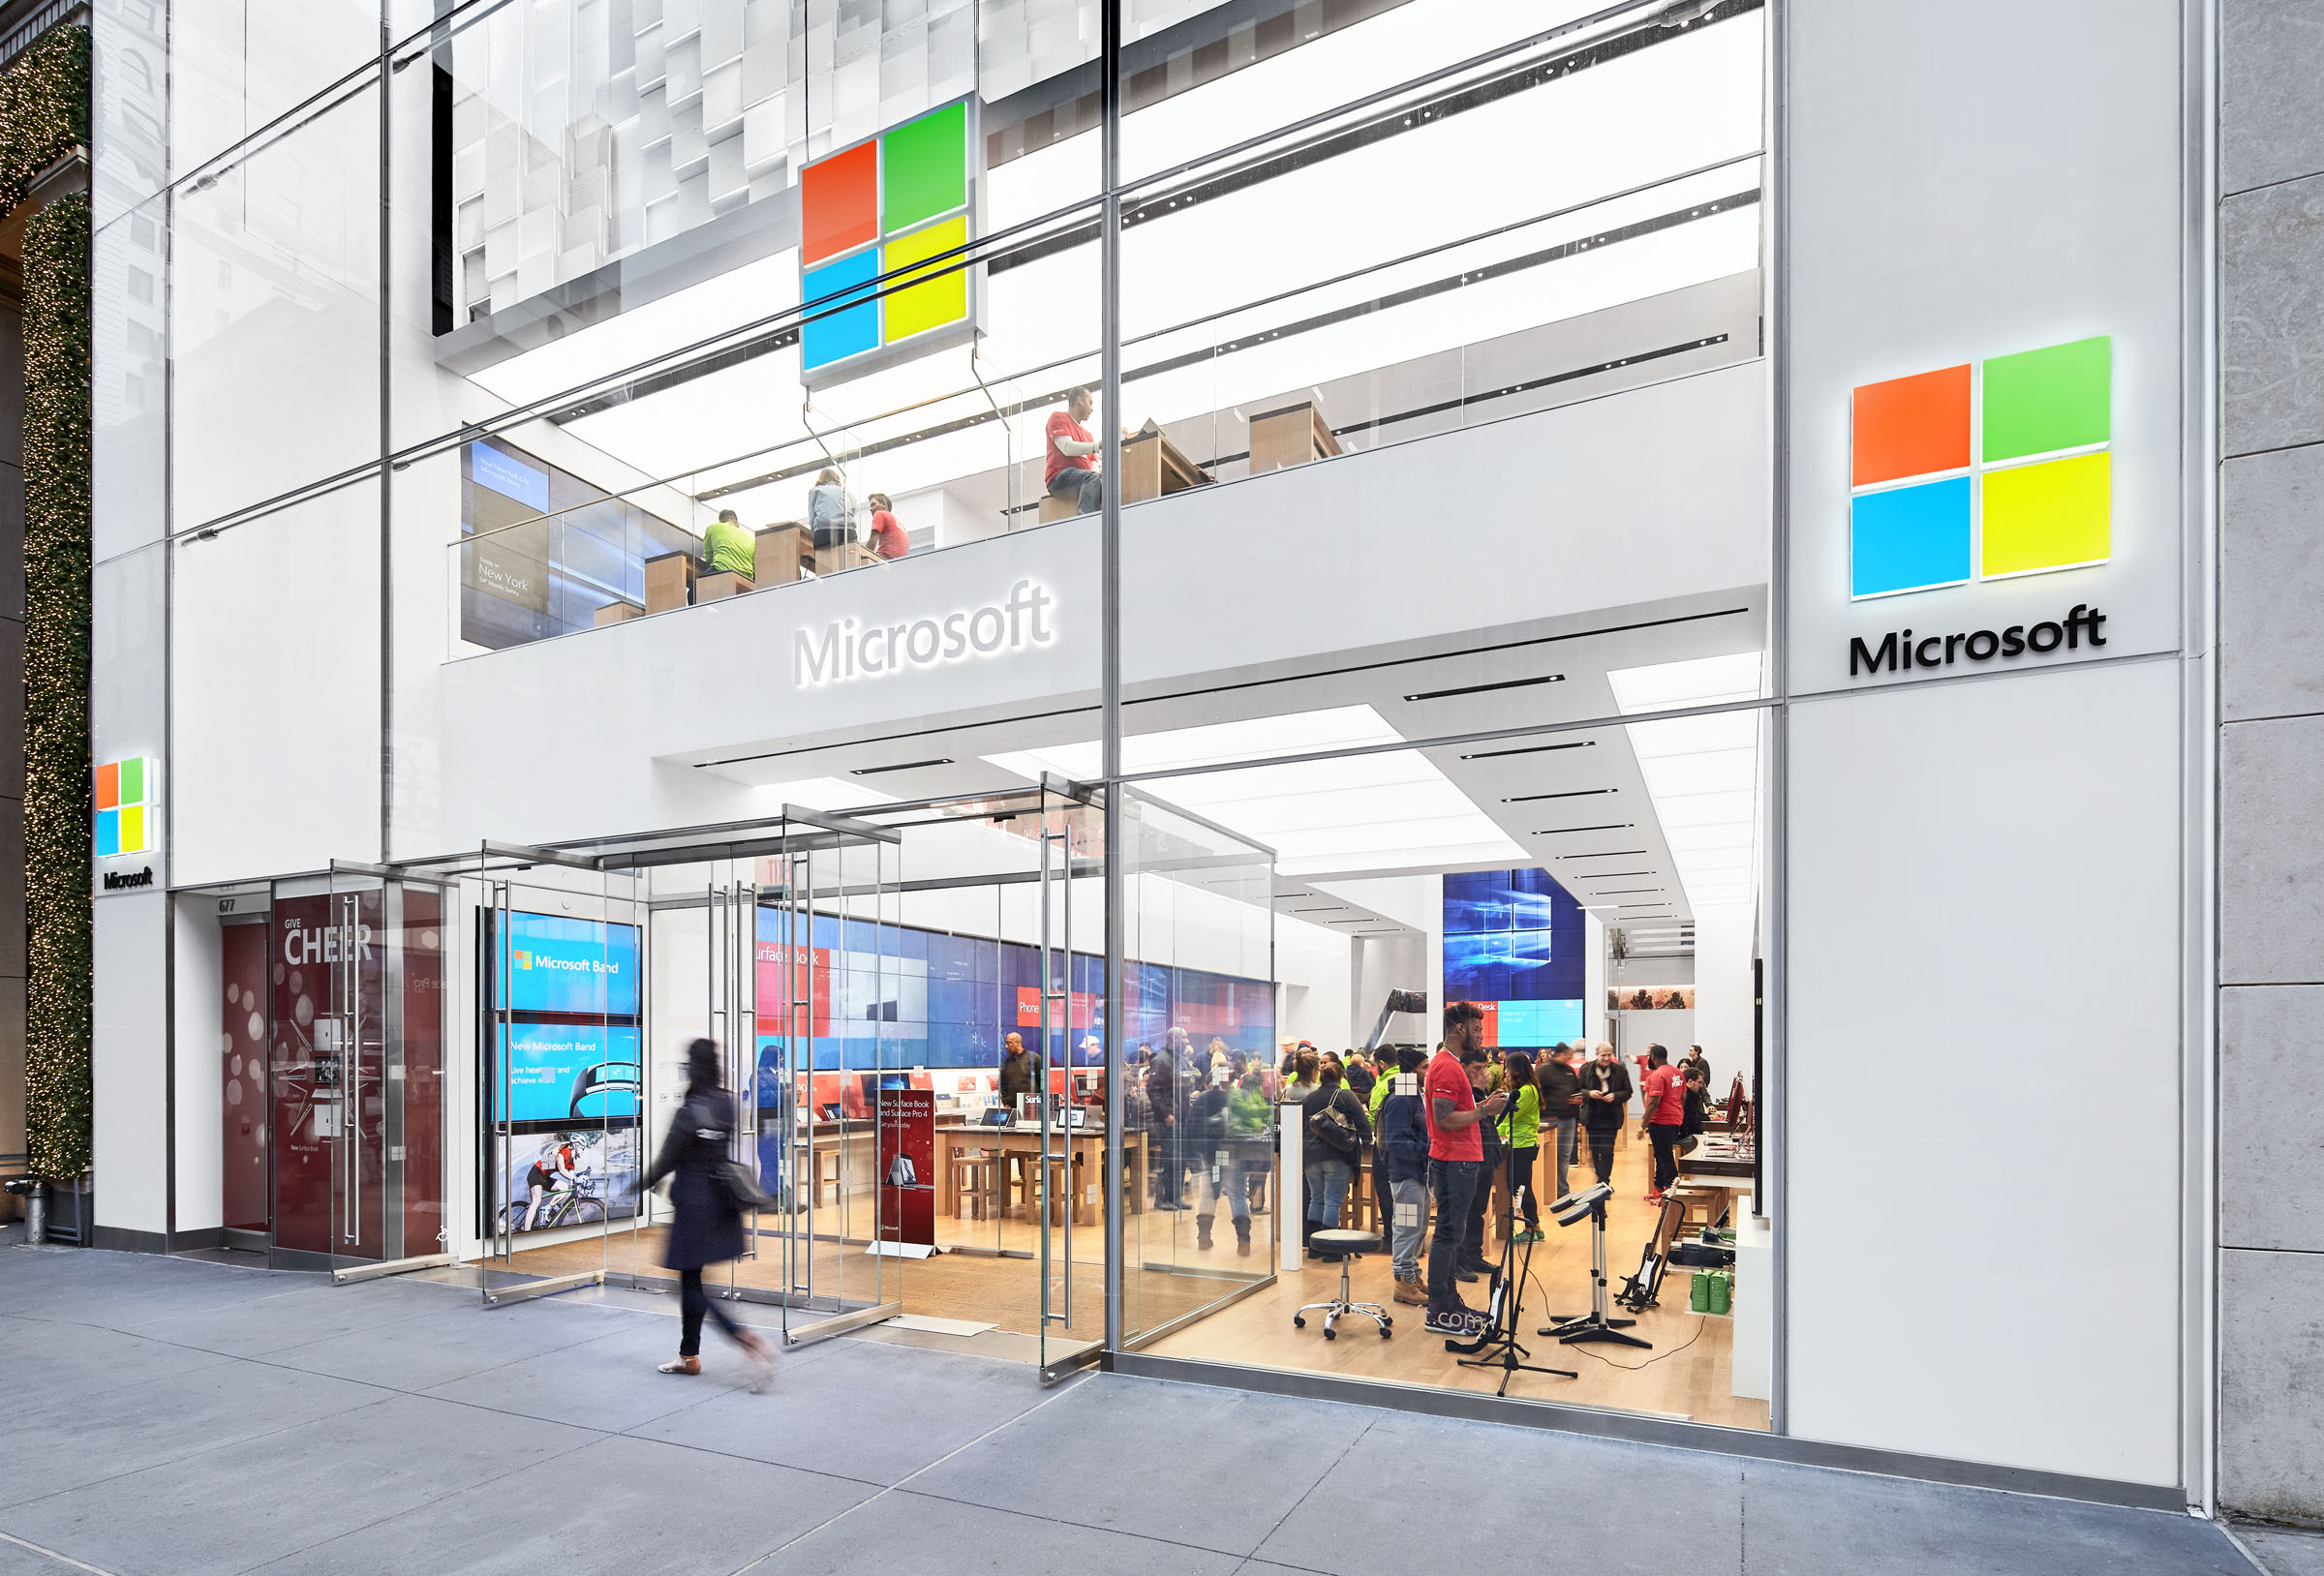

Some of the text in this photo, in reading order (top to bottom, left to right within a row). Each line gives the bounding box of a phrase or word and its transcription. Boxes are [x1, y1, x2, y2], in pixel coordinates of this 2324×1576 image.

[478, 563, 528, 591] New York
[794, 579, 1051, 685] Microsoft
[1850, 603, 2107, 676] Microsoft
[104, 865, 153, 890] Microsoft
[218, 898, 235, 913] 677
[285, 918, 301, 929] GIVE
[285, 924, 373, 965] CHEER
[535, 955, 619, 974] Microsoft Band
[1020, 1001, 1039, 1014] Phone
[511, 1042, 596, 1051] New Microsoft Band
[914, 1100, 930, 1108] Book
